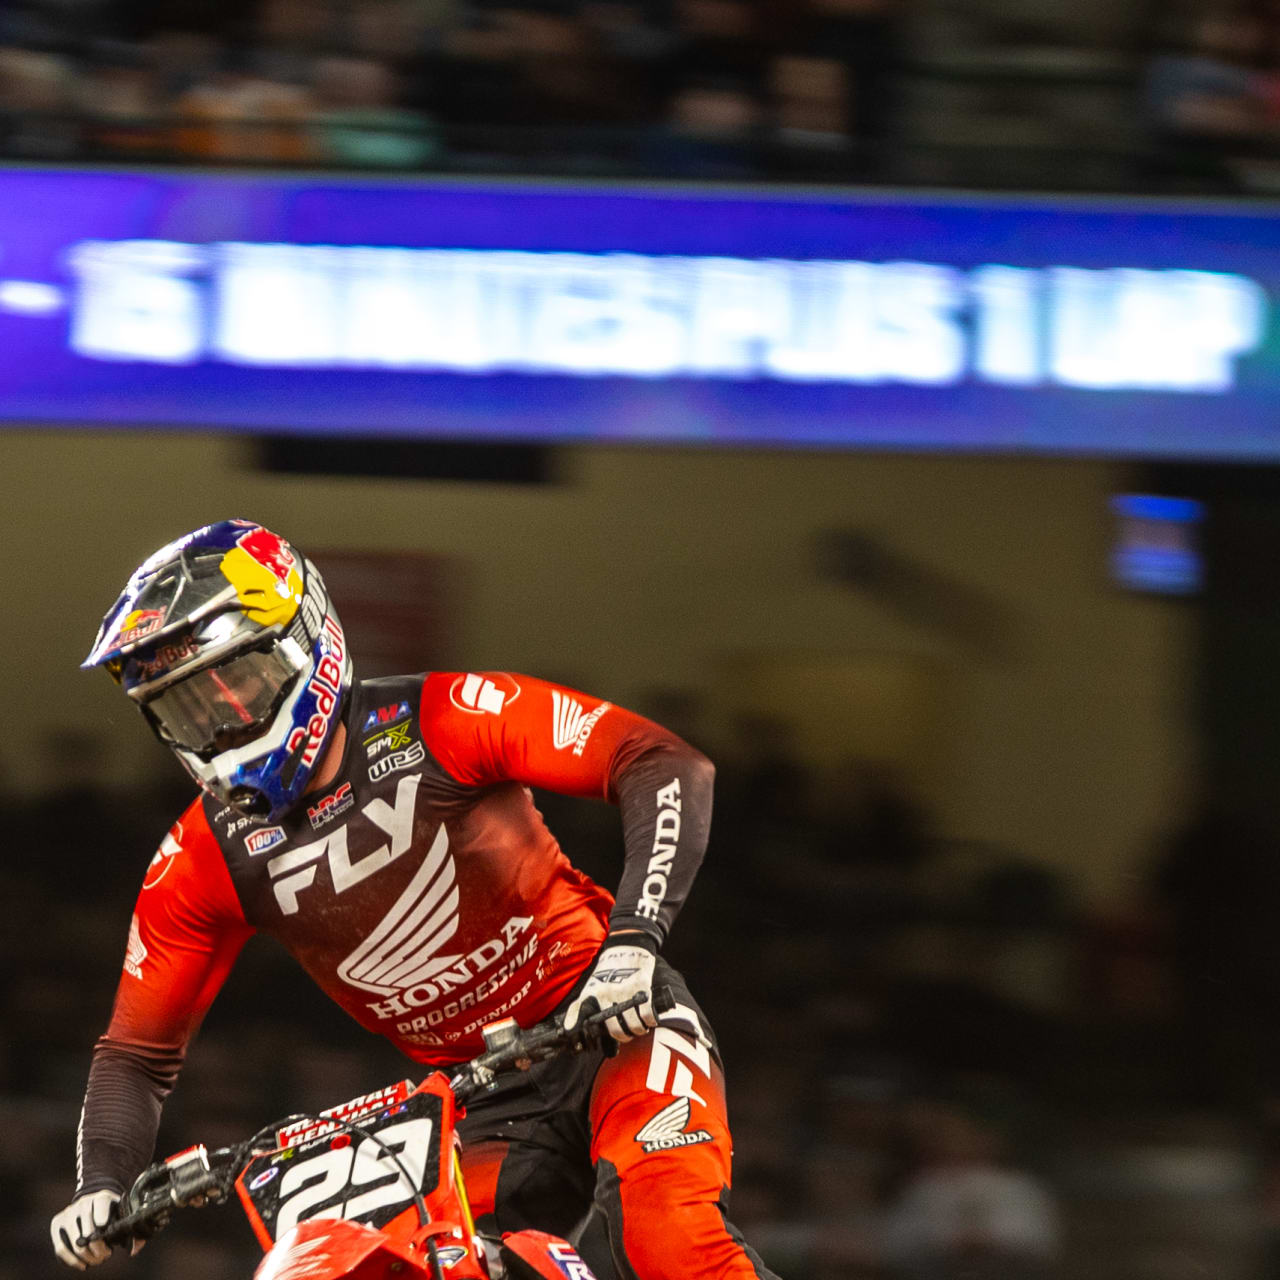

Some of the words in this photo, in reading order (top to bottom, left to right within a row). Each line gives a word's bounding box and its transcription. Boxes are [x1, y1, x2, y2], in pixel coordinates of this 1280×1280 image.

[285, 678, 337, 769] Red
[315, 613, 345, 695] Bull
[362, 701, 412, 733] AMA
[364, 719, 412, 759] SMX
[573, 702, 612, 757] HONDA
[368, 740, 425, 782] WPS
[248, 829, 284, 853] 100%
[267, 773, 422, 915] FLY
[635, 778, 681, 921] HONDA
[366, 915, 534, 1020] HONDA
[397, 933, 538, 1035] PROGRESSIVE
[464, 980, 532, 1035] DUNLOP
[644, 1130, 713, 1153] HONDA
[275, 1117, 433, 1242] 29
